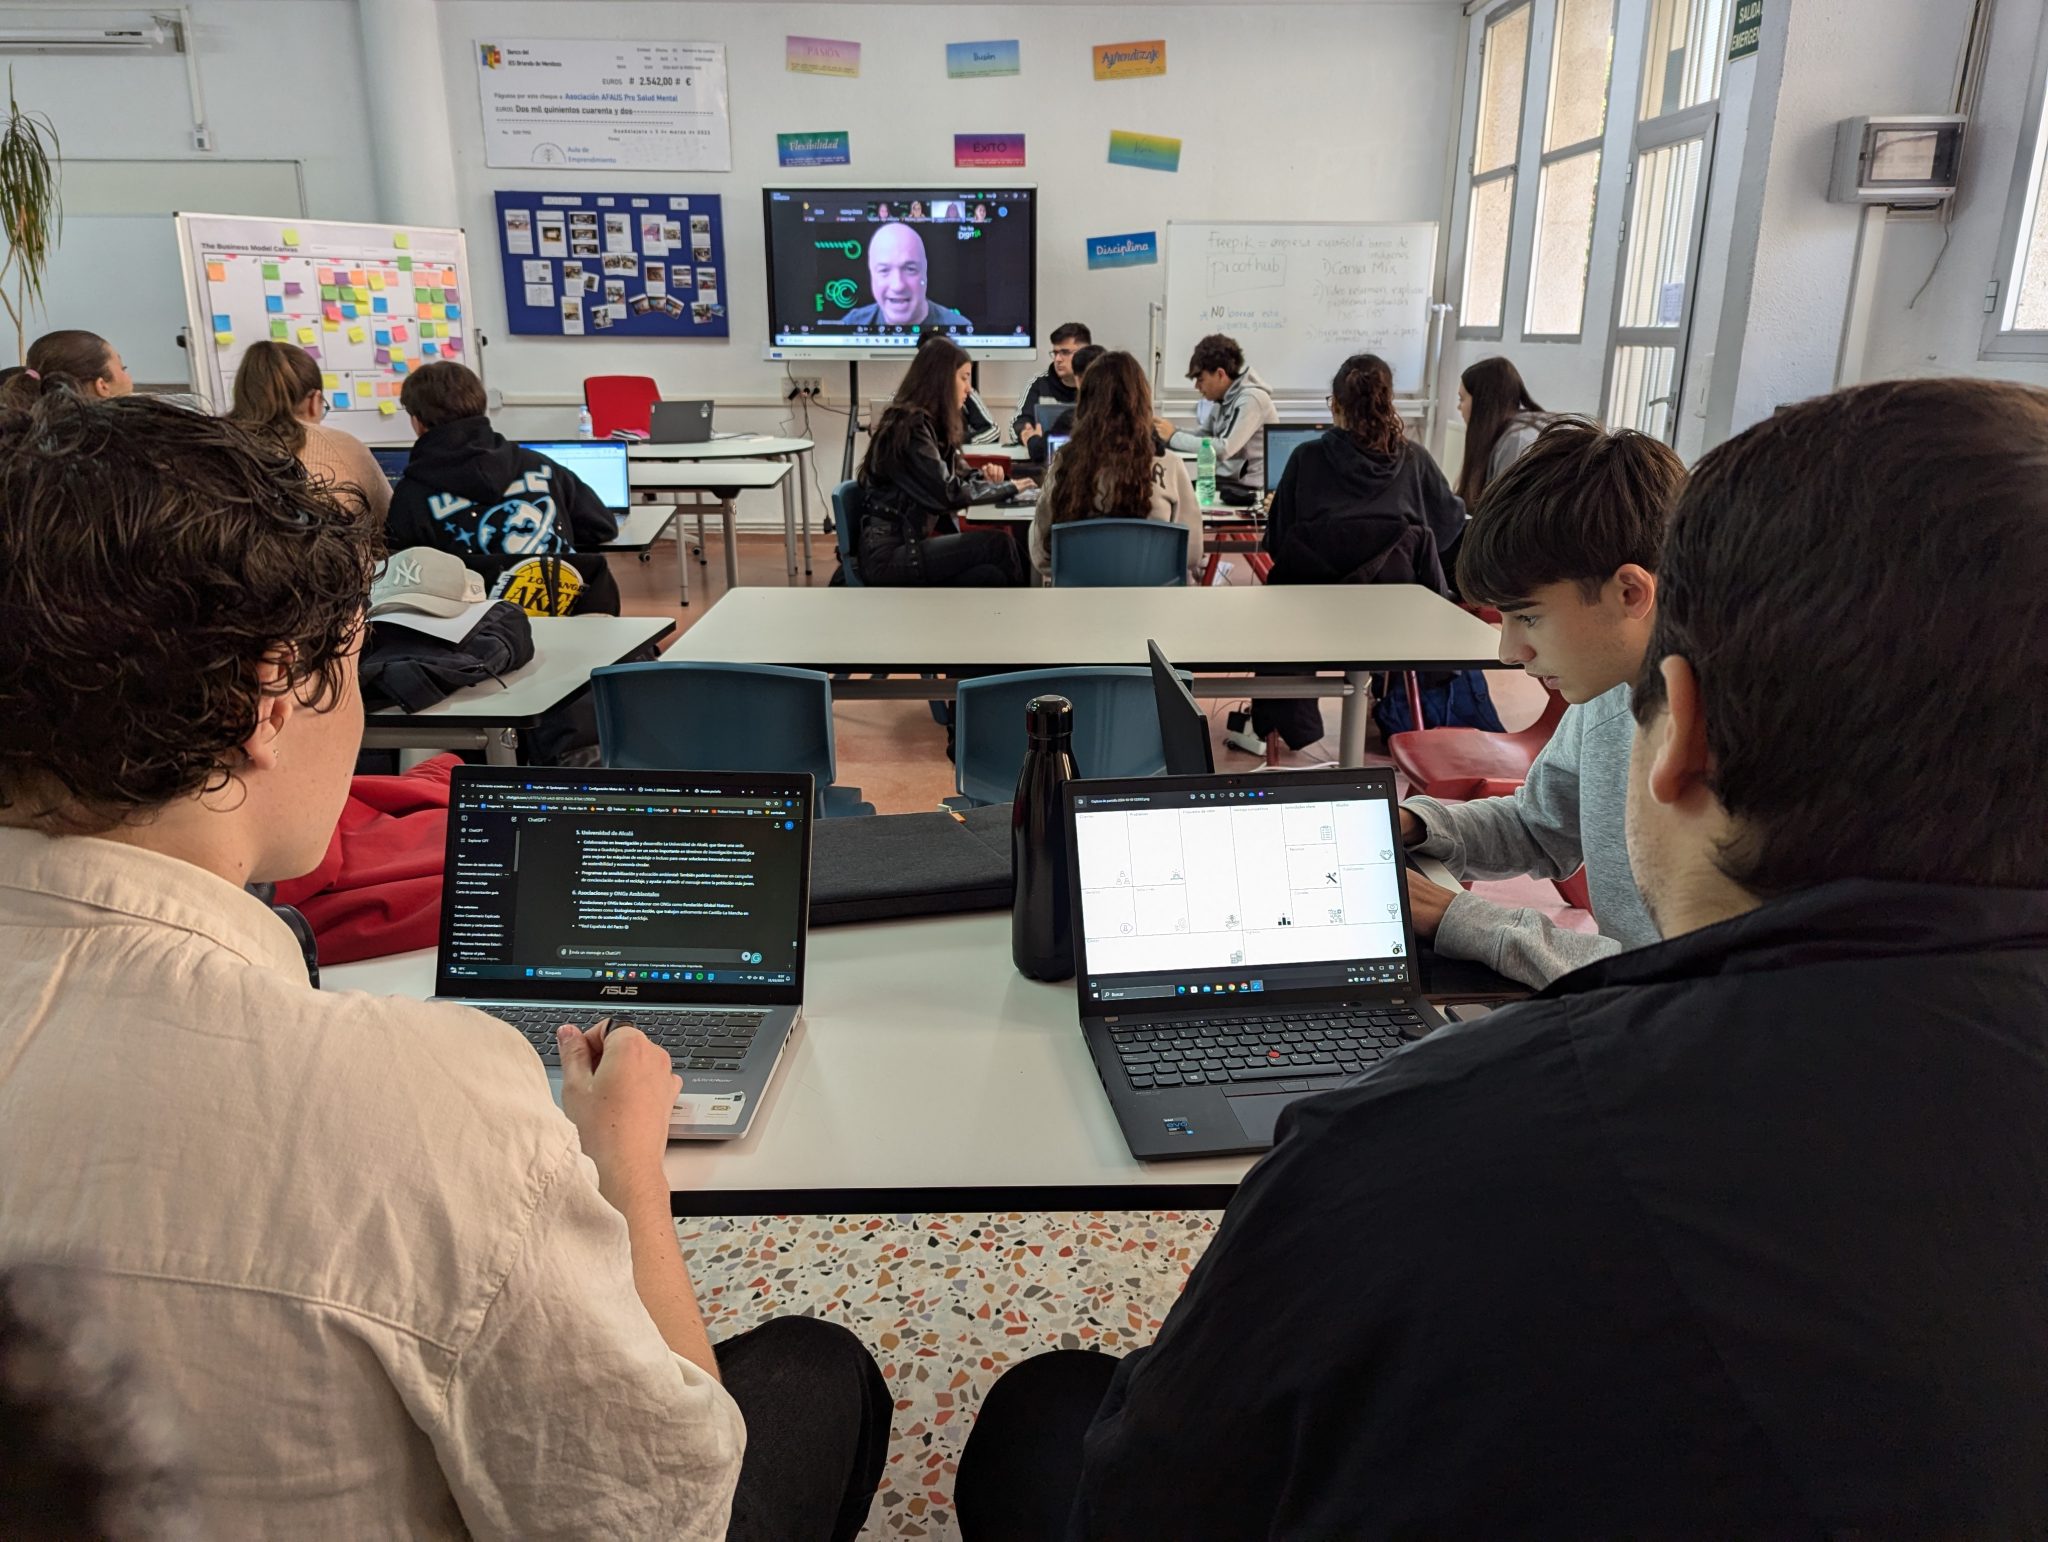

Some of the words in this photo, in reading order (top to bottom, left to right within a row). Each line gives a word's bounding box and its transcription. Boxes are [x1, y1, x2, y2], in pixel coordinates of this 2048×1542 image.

[640, 77, 673, 86] 2.542,00
[1096, 239, 1148, 256] Disciplina
[1211, 306, 1225, 318] NO
[600, 986, 638, 995] ASUS
